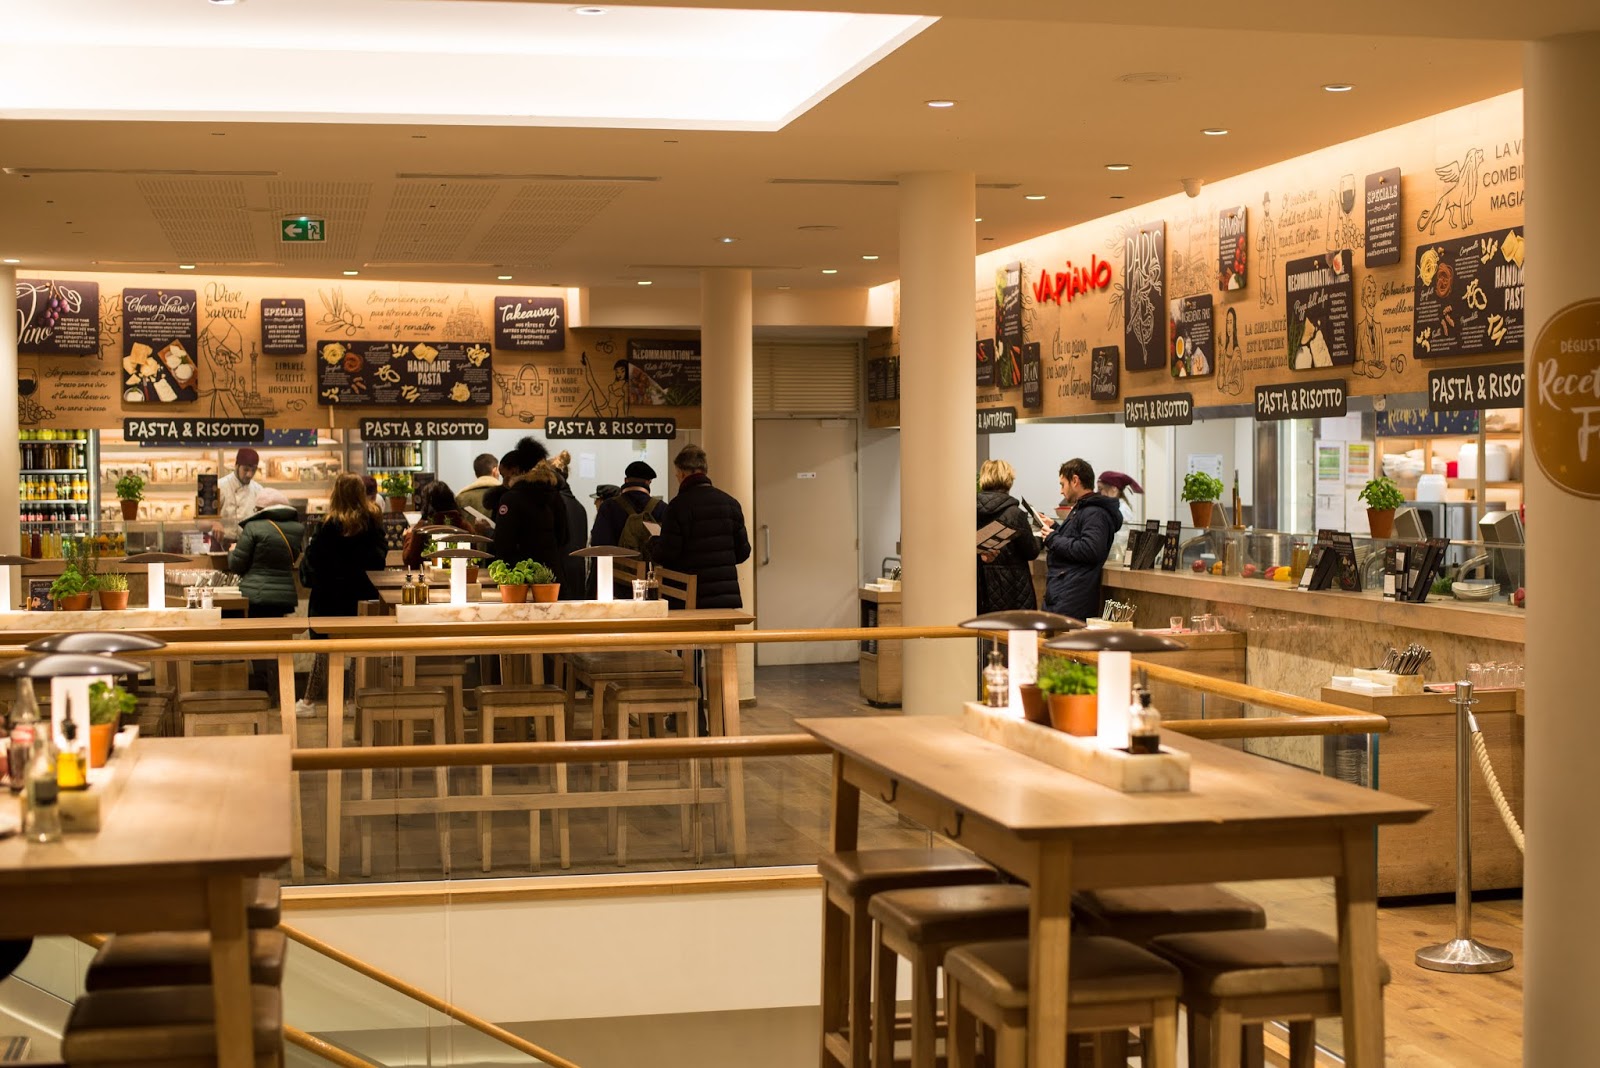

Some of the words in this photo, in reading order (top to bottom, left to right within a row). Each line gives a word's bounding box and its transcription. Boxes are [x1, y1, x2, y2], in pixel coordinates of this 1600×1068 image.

[1495, 142, 1511, 159] LA
[1482, 164, 1524, 187] COMBI
[1367, 184, 1398, 204] SPECIALS
[1126, 230, 1161, 290] PARIS
[204, 282, 242, 303] Vive
[124, 294, 157, 313] Cheese
[264, 307, 303, 317] SPECIALS
[499, 303, 560, 327] Takeaway
[394, 324, 401, 338] y
[1244, 323, 1253, 336] LA
[1254, 314, 1287, 335] SIMPLICITÉ
[1052, 327, 1064, 361] Chi
[1064, 341, 1071, 354] va
[1246, 340, 1257, 353] EST
[407, 360, 451, 373] HANDMADE
[1046, 366, 1054, 379] va
[275, 372, 306, 383] ÉGALITÉ,
[417, 372, 442, 386] PASTA
[268, 384, 313, 394] HOSPITALITÉ
[1063, 384, 1070, 397] va
[1432, 374, 1474, 404] PASTA
[1477, 375, 1486, 400] &
[1258, 390, 1290, 415] PASTA
[1291, 390, 1298, 411] &
[1300, 387, 1342, 410] RISOTTO
[1126, 401, 1149, 422] PASTA
[1150, 402, 1156, 419] &
[1156, 400, 1189, 418] RISOTTO
[548, 421, 595, 436] PASTA
[599, 421, 608, 434] &
[612, 421, 674, 434] RISOTTO
[983, 411, 1012, 429] ANTIPASTI
[129, 422, 178, 438] PASTA
[183, 422, 193, 436] &
[196, 422, 259, 436] RISOTTO
[365, 422, 410, 437] PASTA
[414, 422, 424, 436] &
[427, 422, 484, 436] RISOTTO
[1571, 406, 1600, 462] F
